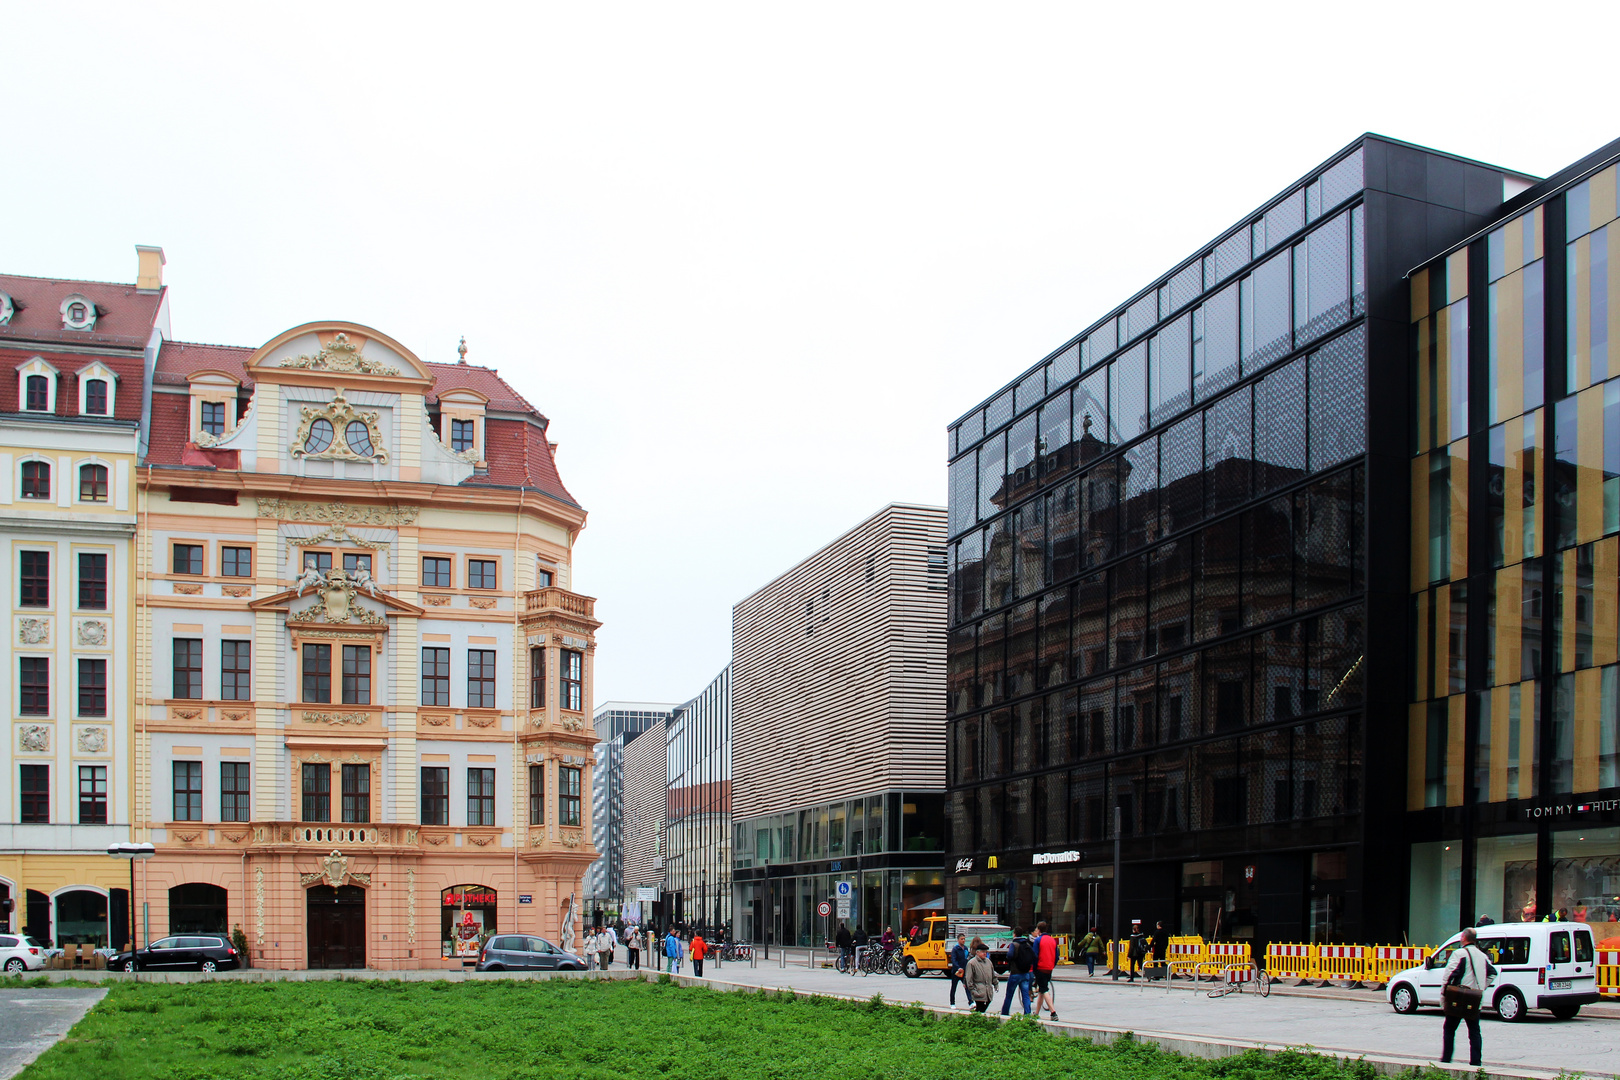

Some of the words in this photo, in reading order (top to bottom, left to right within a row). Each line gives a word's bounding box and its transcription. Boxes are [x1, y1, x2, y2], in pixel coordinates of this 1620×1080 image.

[1525, 804, 1573, 818] TOMMY
[1032, 850, 1080, 865] McDonald's
[443, 893, 496, 905] APOTHEKE
